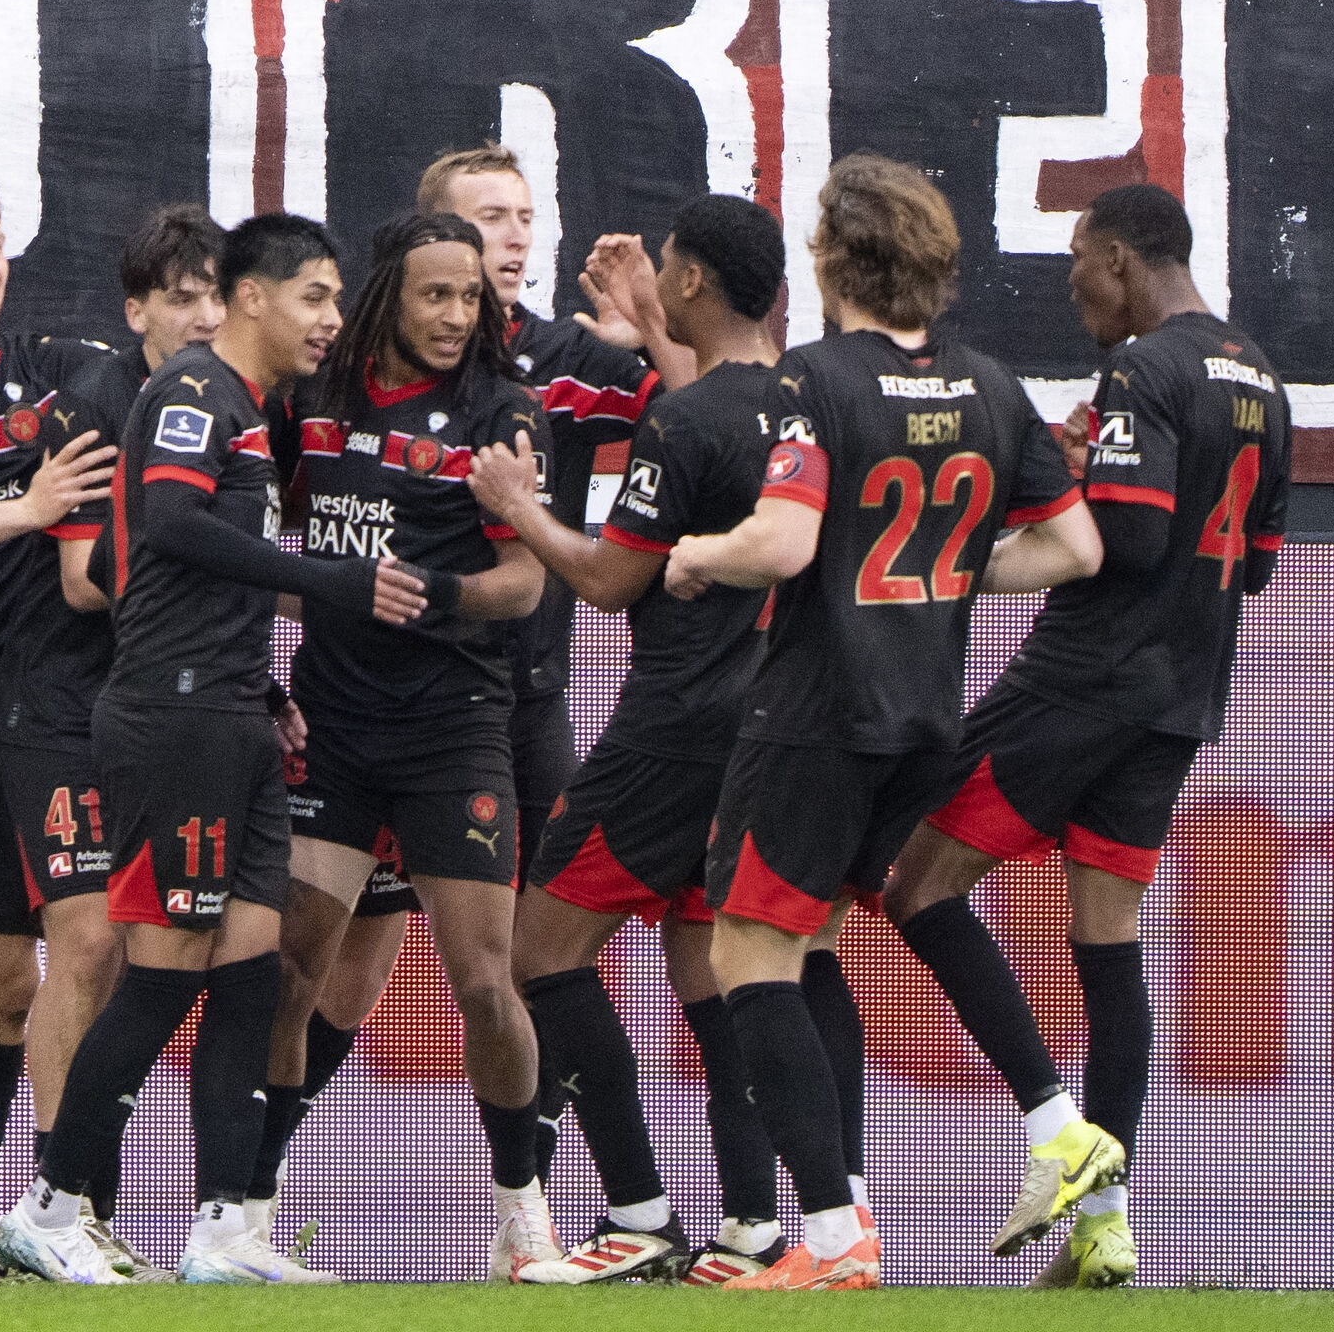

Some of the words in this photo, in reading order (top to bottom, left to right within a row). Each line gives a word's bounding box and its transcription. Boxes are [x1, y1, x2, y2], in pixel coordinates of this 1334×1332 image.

[906, 410, 963, 446] BECH
[307, 517, 396, 561] BANK
[310, 493, 396, 525] vestjysk
[854, 450, 996, 606] 22
[1194, 442, 1261, 591] 4
[44, 786, 104, 846] 41
[177, 816, 227, 878] 11
